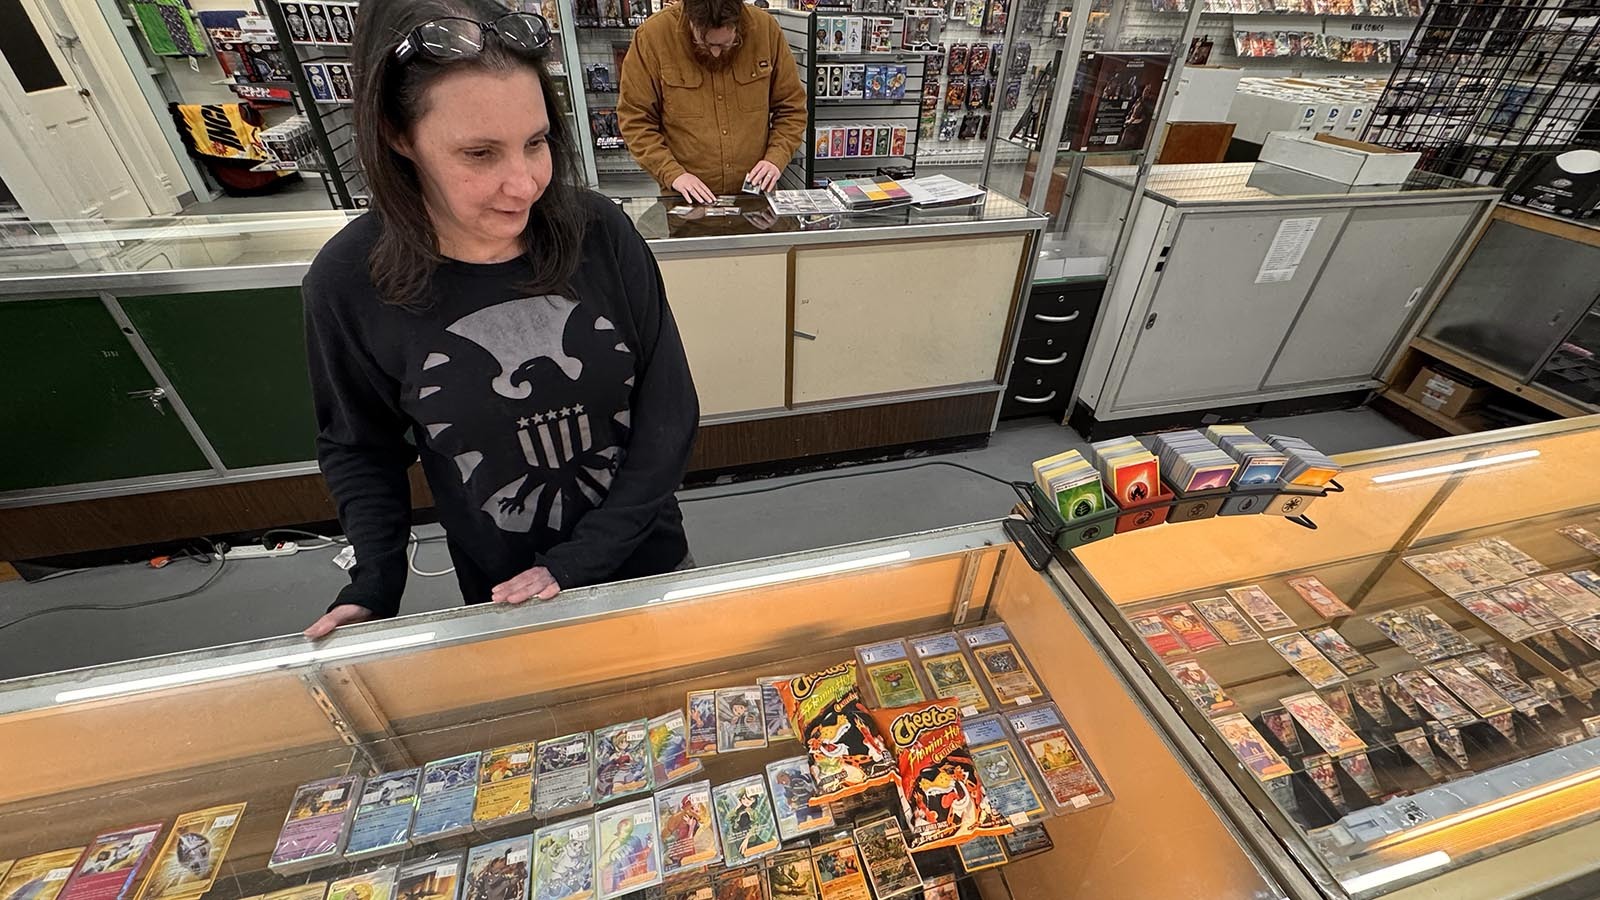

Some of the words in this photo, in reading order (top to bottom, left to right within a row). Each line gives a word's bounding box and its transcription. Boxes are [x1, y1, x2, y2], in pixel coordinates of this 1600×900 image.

[1351, 23, 1362, 31] NEW
[1363, 23, 1385, 32] COMICS
[891, 705, 959, 747] Cheetos
